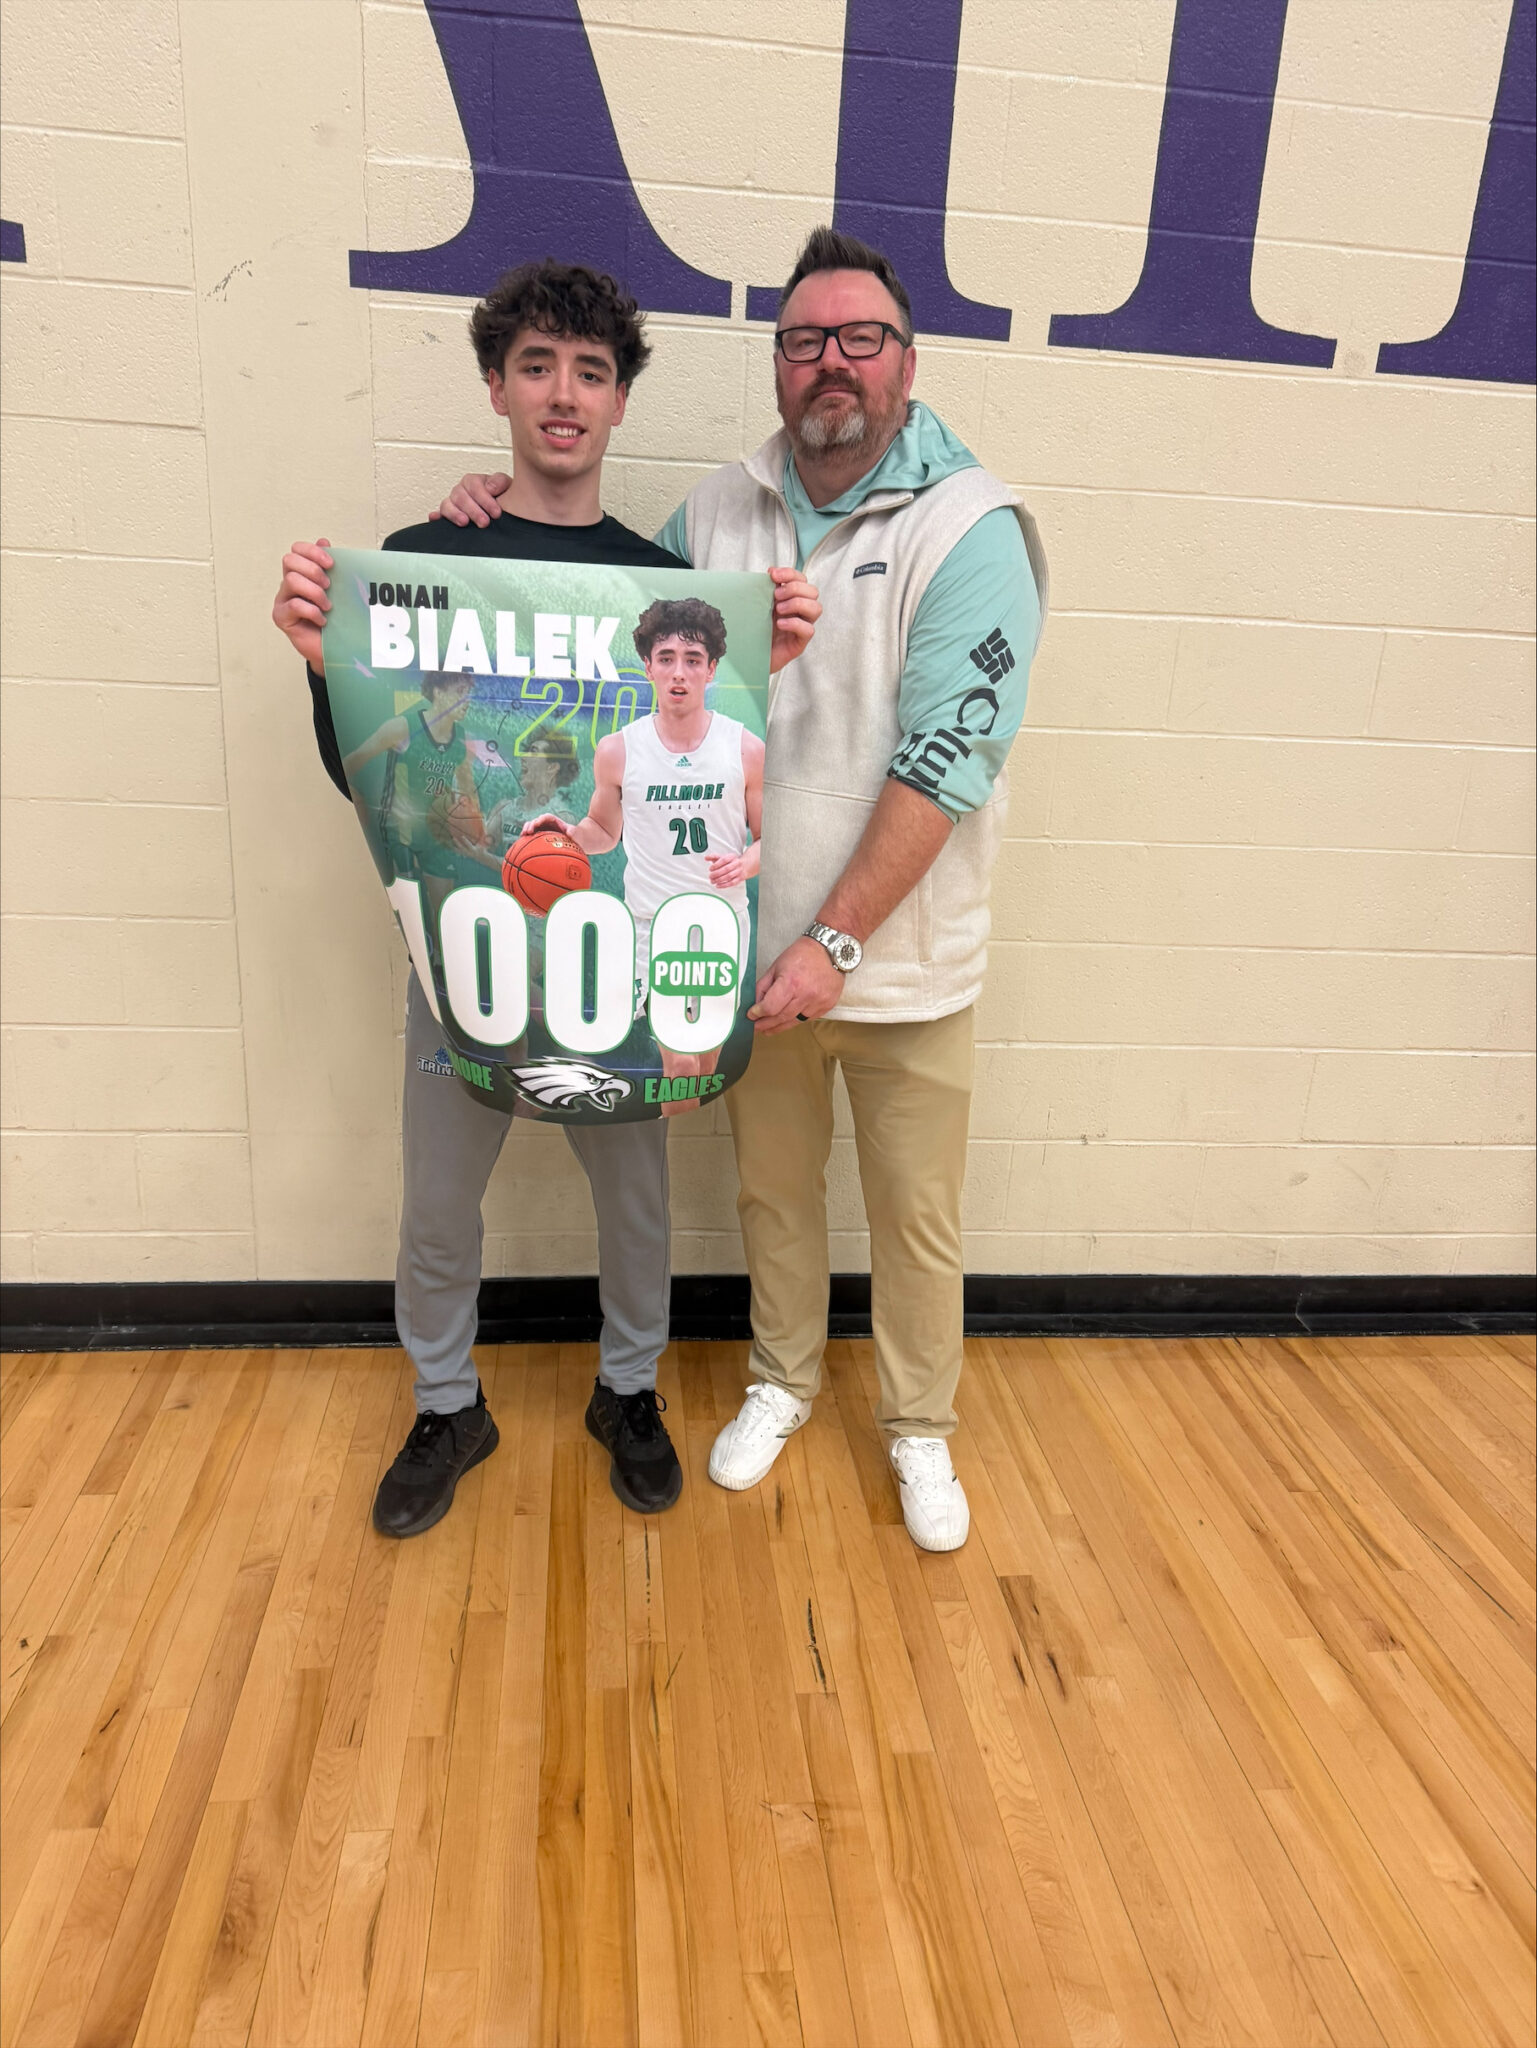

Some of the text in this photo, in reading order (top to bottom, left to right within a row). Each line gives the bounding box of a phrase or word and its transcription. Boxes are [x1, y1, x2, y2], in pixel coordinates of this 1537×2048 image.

[368, 582, 449, 610] JONAH
[370, 604, 621, 682] BIALEK
[514, 667, 658, 758] 20
[424, 776, 446, 797] 20
[645, 783, 725, 802] FILLMORE
[669, 818, 709, 855] 20
[386, 876, 740, 1055] 1000
[654, 960, 733, 988] POINTS
[644, 1073, 726, 1104] EAGLES
